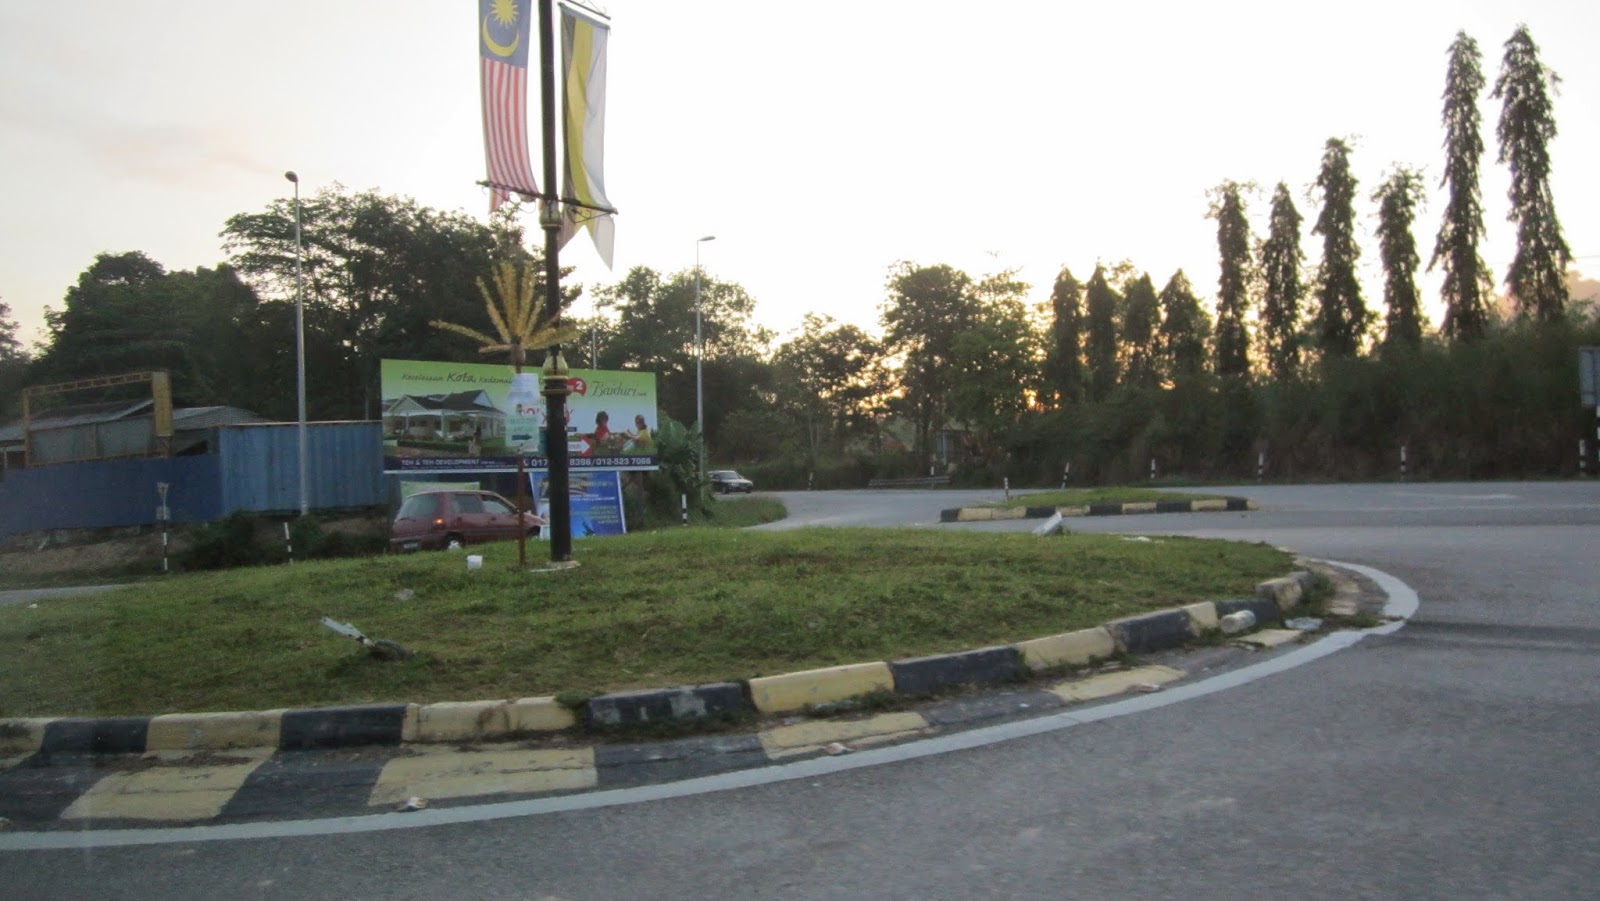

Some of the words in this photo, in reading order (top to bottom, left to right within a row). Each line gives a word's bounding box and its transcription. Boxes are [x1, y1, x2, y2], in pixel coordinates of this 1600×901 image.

[576, 381, 583, 390] 2
[589, 381, 637, 397] Baiduri
[435, 458, 480, 466] DEVELOPMENT
